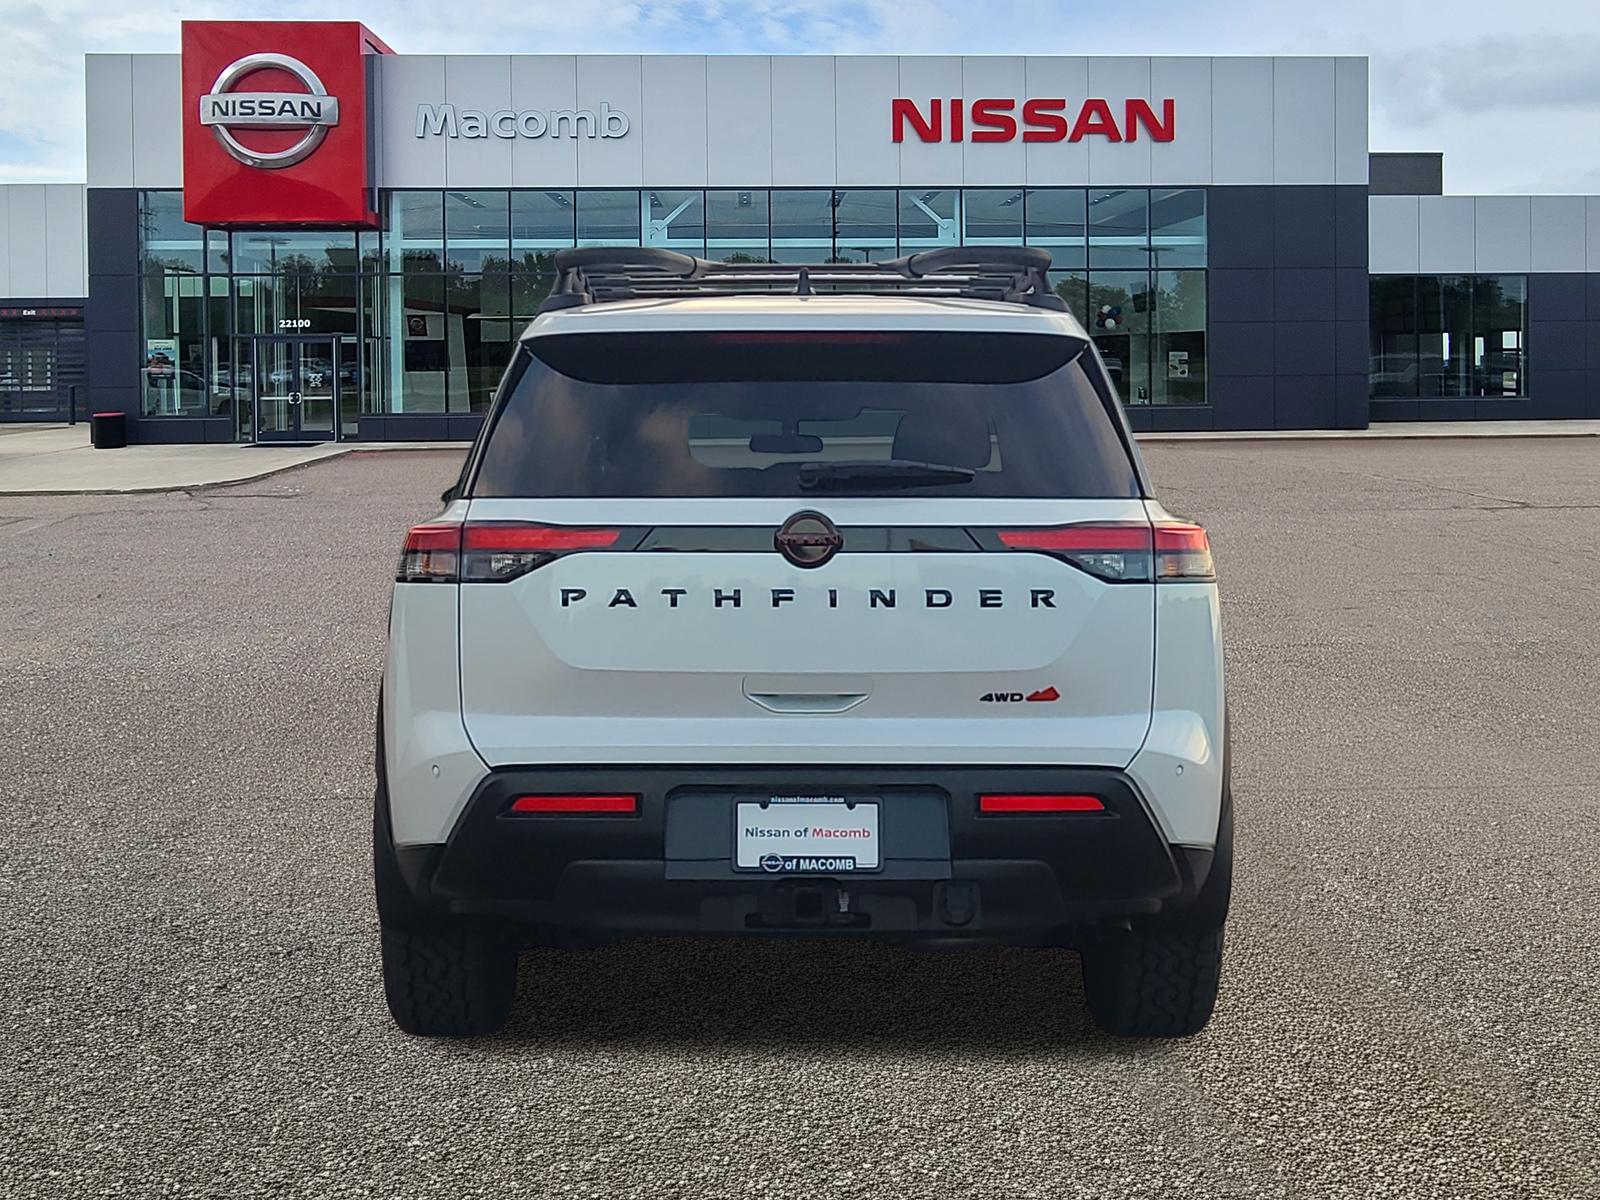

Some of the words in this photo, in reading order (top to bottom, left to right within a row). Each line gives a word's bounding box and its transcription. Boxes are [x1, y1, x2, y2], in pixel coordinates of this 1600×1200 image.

[211, 100, 322, 118] NISSAN
[415, 102, 630, 139] Macomb
[892, 98, 1175, 142] NISSAN
[279, 319, 311, 328] 22100
[560, 588, 1057, 609] PATHFINDER
[979, 692, 1024, 702] 4WD
[745, 826, 790, 838] Nissan
[794, 826, 809, 838] of
[812, 827, 871, 839] Macomb
[784, 859, 798, 870] of
[800, 859, 855, 870] MACOMB
